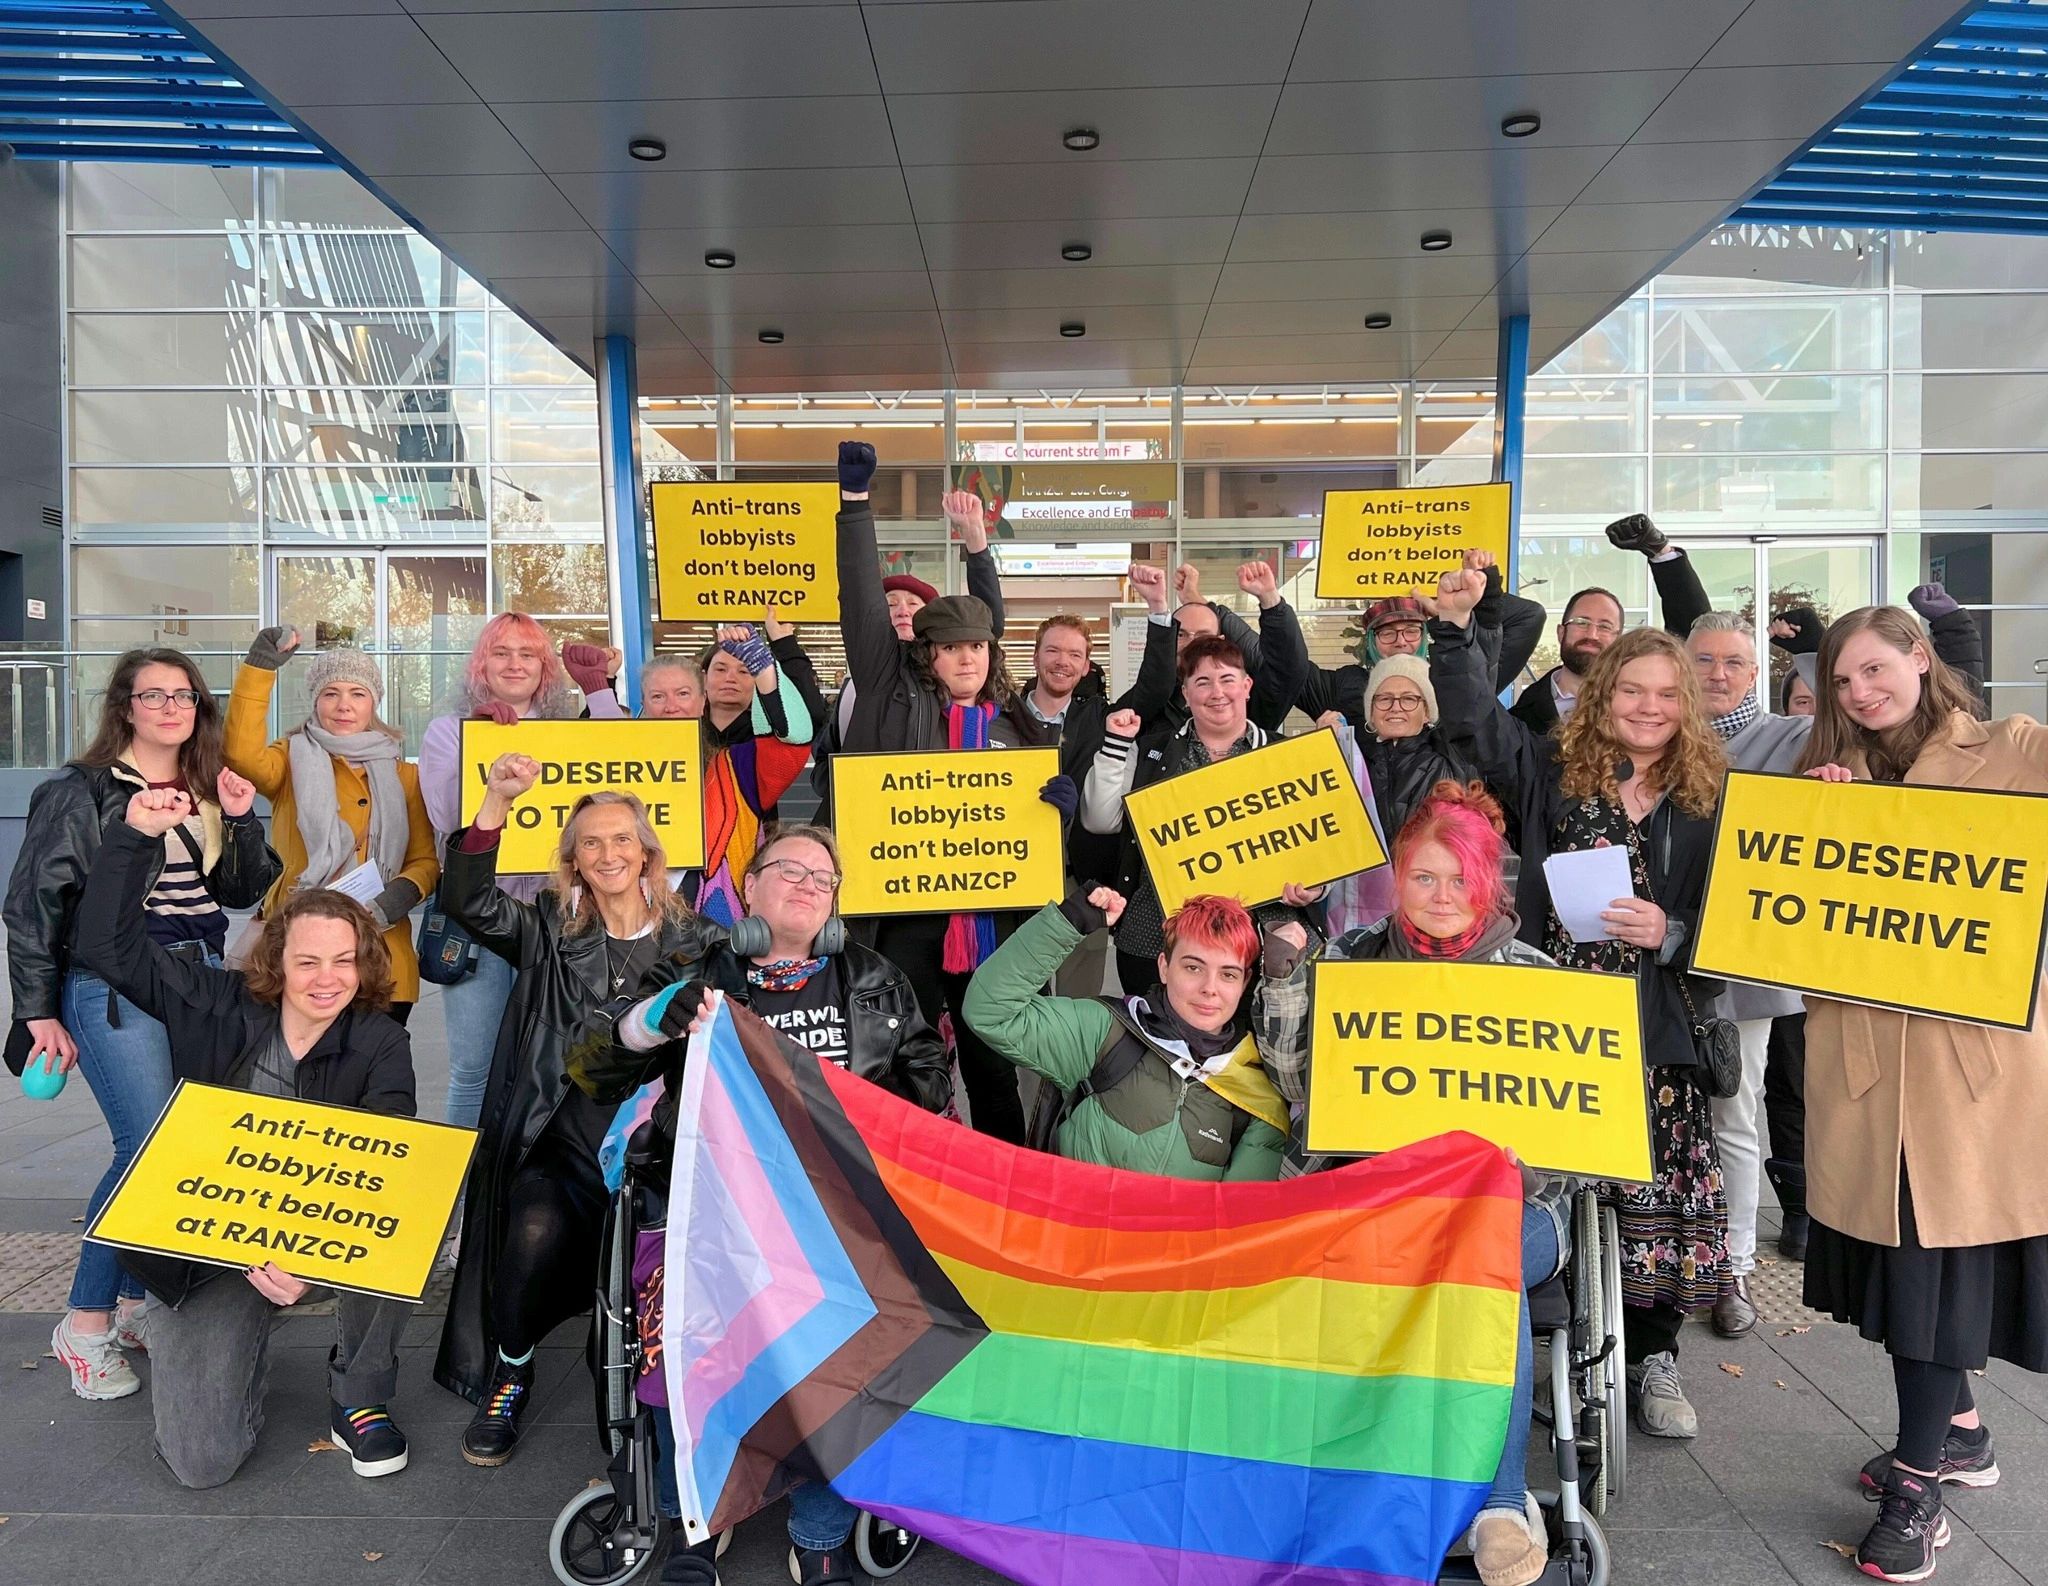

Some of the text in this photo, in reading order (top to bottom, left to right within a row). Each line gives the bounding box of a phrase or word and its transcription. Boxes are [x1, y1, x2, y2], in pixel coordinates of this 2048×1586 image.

[1005, 446, 1073, 458] Concurrent
[1124, 445, 1132, 456] F
[691, 497, 801, 515] Anti-trans
[1022, 507, 1085, 518] Excellence
[1088, 506, 1110, 518] and
[1361, 500, 1471, 514] Anti-trans
[700, 528, 796, 551] lobbyists
[1367, 523, 1462, 541] lobbyists
[1347, 547, 1474, 562] don't belon
[684, 559, 816, 581] don't belong
[1356, 571, 1449, 585] at RANZ
[697, 589, 806, 606] at RANZCP
[541, 760, 687, 785] DESERVE
[881, 769, 1013, 792] Anti-trans
[890, 802, 1006, 829] lobbyists
[1149, 768, 1340, 847] WE DESERVE
[870, 837, 1028, 861] don't belong
[1178, 812, 1341, 881] TO THRIVE
[1737, 829, 2028, 894] WE DESERVE
[884, 871, 1017, 894] at RANZCP
[1748, 889, 1991, 955] TO THRIVE
[761, 1005, 846, 1029] VER WIL
[787, 1026, 847, 1049] NDE
[1332, 1011, 1622, 1060] WE DESERVE
[1353, 1065, 1601, 1116] TO THRIVE
[230, 1112, 410, 1159] Anti-trans
[225, 1145, 385, 1193] lobbyists
[176, 1176, 401, 1239] don't belong
[175, 1216, 369, 1265] at RANZCP
